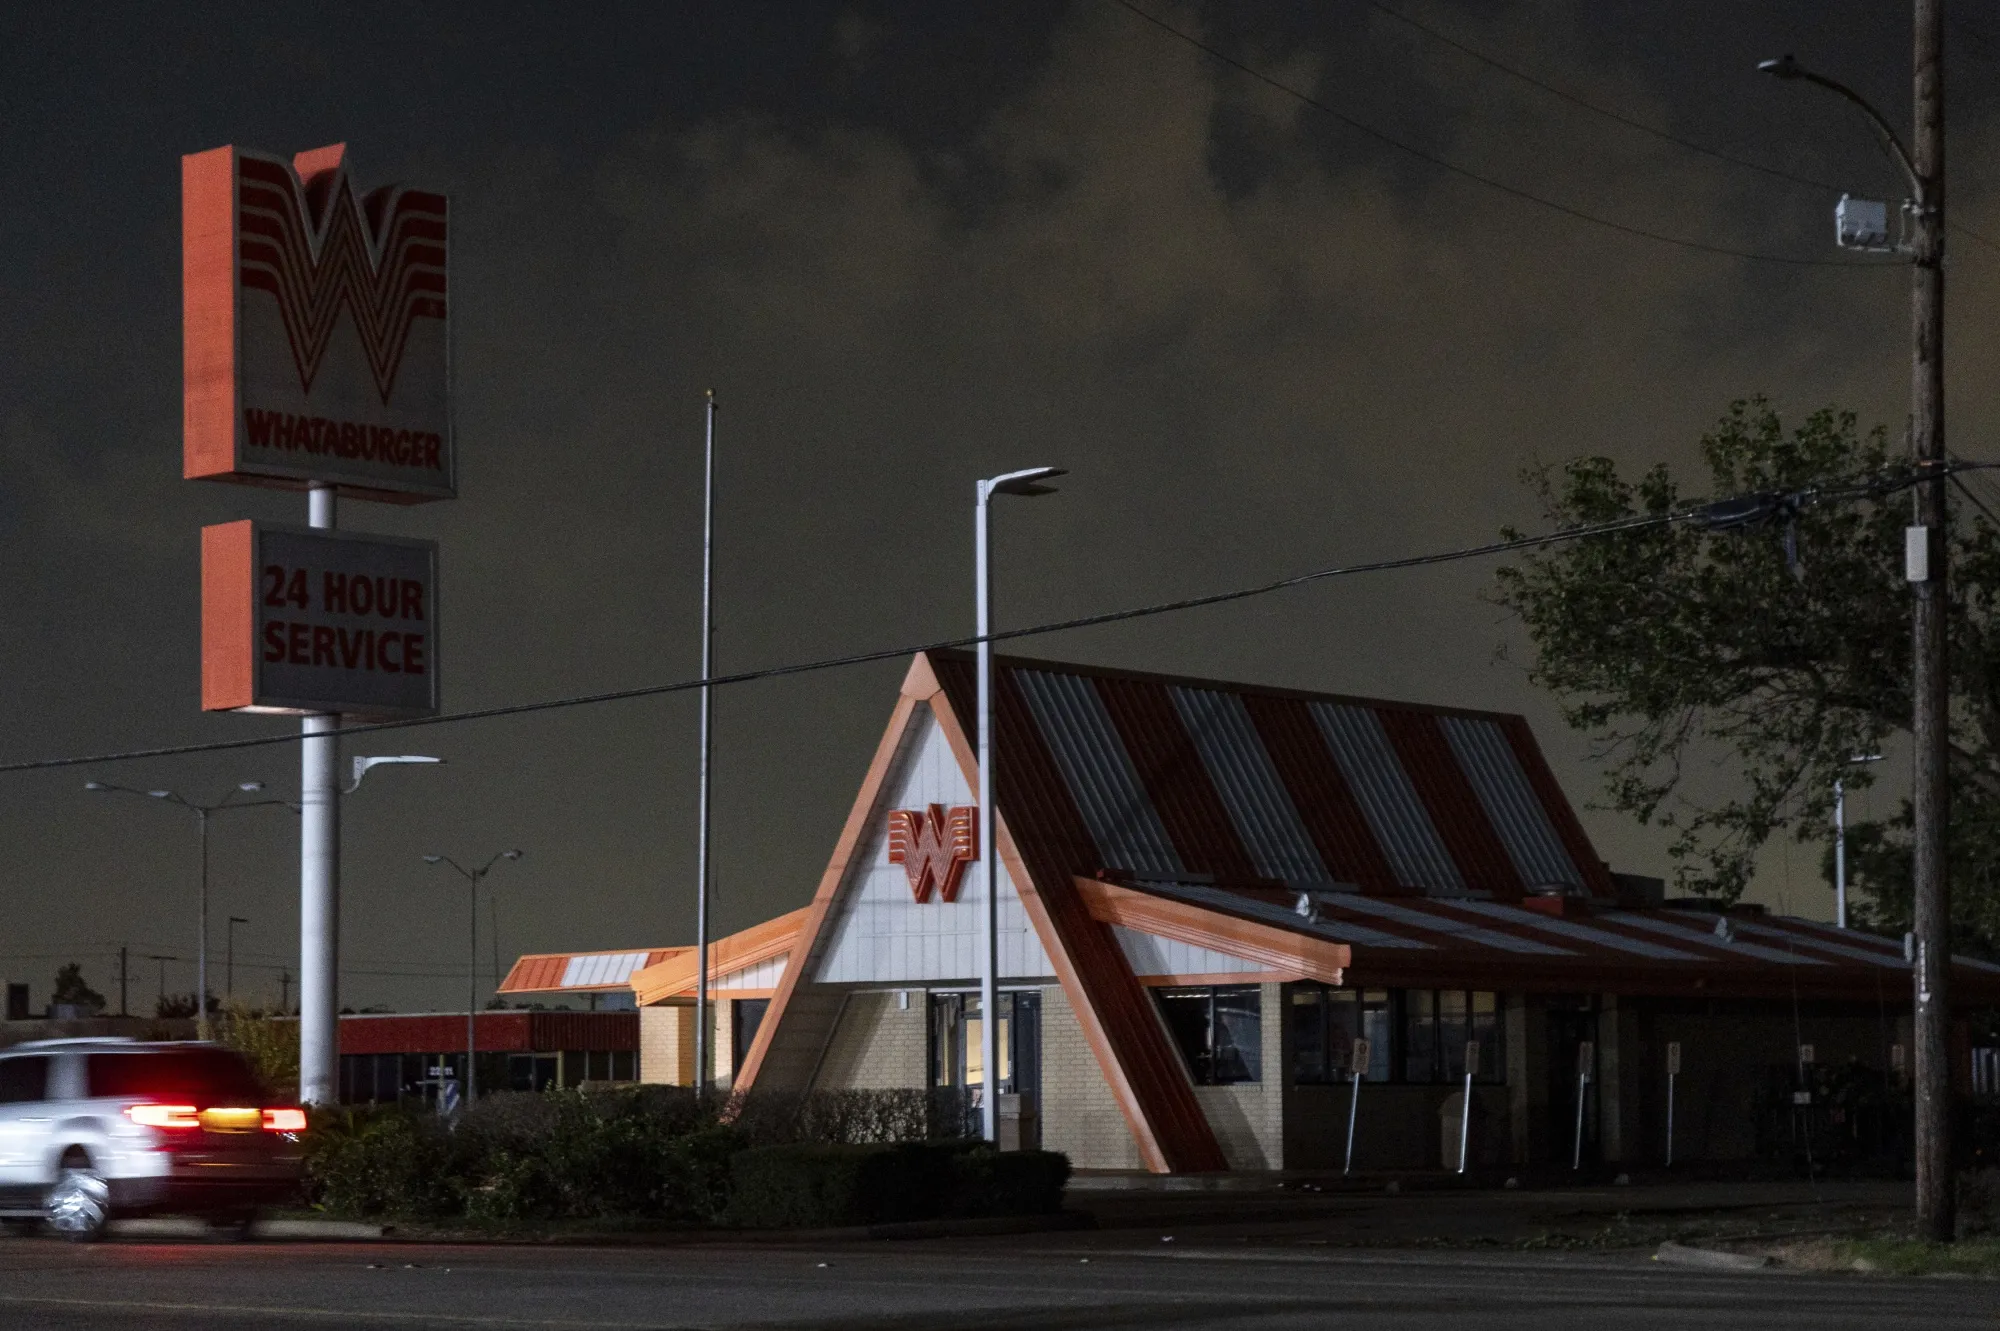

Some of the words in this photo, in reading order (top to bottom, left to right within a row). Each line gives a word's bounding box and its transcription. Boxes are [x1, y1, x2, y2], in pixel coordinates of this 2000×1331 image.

[239, 155, 448, 408] W
[244, 407, 441, 471] WHATABURGER
[265, 565, 309, 609] 24
[324, 571, 424, 620] HOUR
[264, 620, 425, 674] SERVICE
[888, 803, 979, 904] W
